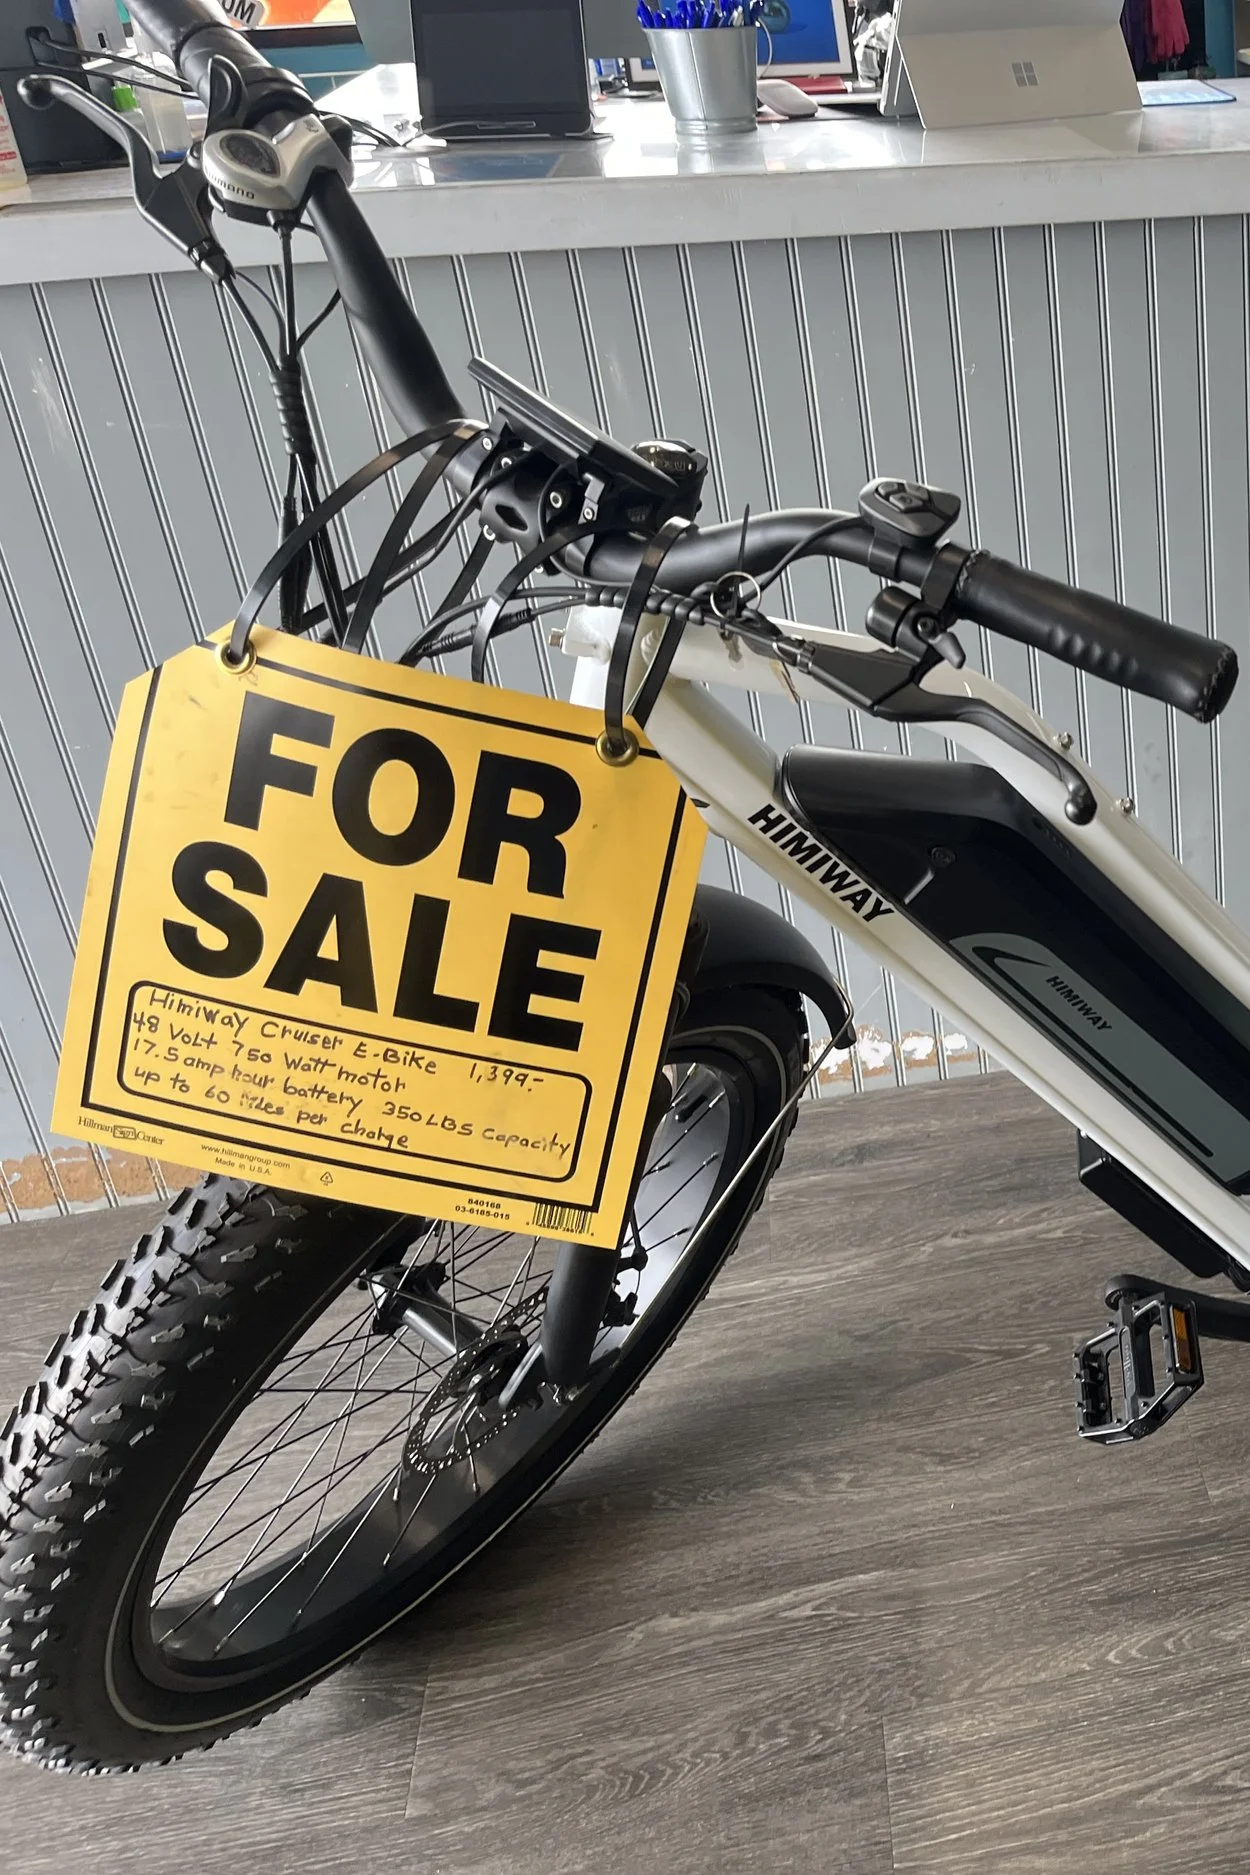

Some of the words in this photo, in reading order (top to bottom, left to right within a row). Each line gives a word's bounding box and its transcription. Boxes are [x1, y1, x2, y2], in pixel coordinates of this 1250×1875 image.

[224, 691, 582, 899] FOR
[747, 803, 895, 922] HIMIWAY
[163, 841, 602, 1052] SALE
[1046, 975, 1113, 1030] HIMIWAY
[133, 1011, 160, 1033] 48
[232, 1040, 272, 1064] 750
[284, 1052, 337, 1075] Watt
[337, 1068, 406, 1094] motor
[260, 1021, 344, 1050] Cruiser
[133, 1038, 180, 1063] 17.5
[183, 1056, 225, 1079] amp
[283, 1076, 363, 1118] battery
[134, 1066, 161, 1086] up
[170, 1073, 190, 1094] to
[204, 1085, 230, 1104] 60
[296, 1110, 328, 1126] per
[78, 1116, 113, 1134] Hillman
[136, 1130, 165, 1145] Center
[200, 1143, 291, 1170] www.hillmangroup.com
[214, 1157, 236, 1169] Made
[238, 1162, 246, 1170] in
